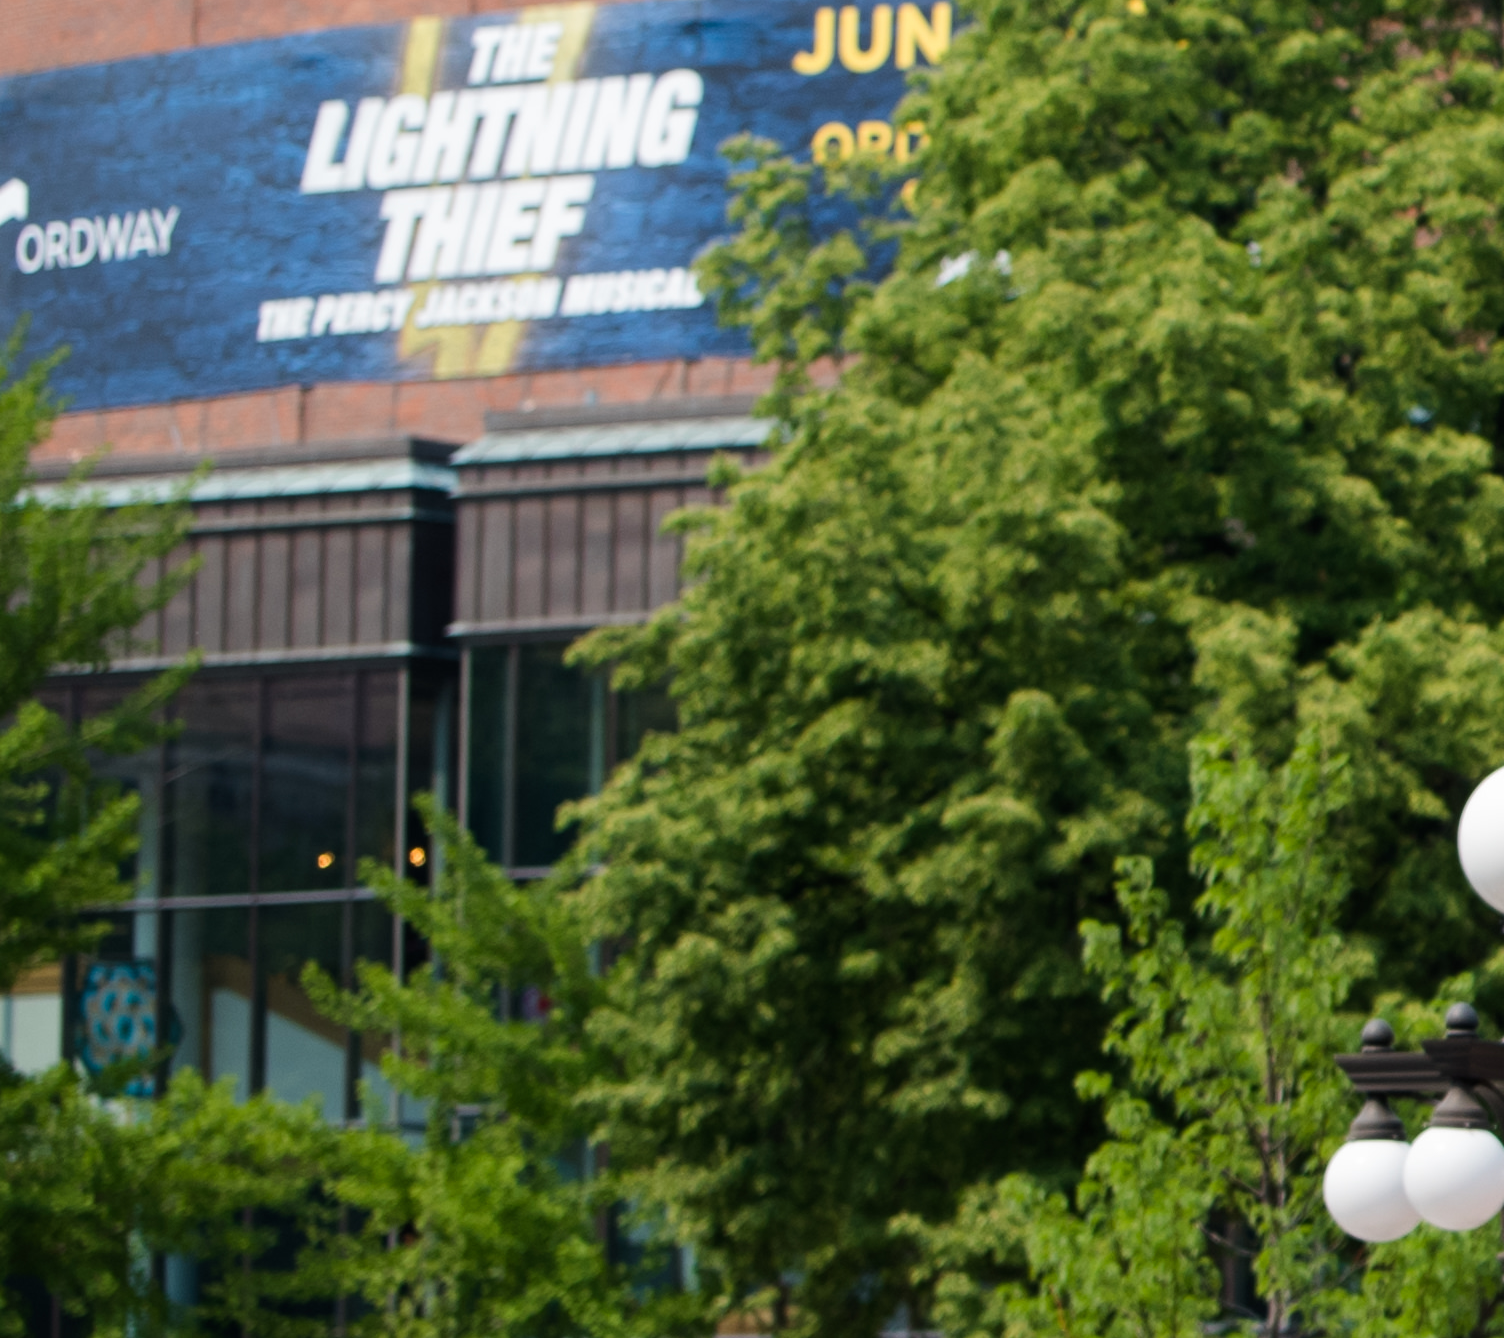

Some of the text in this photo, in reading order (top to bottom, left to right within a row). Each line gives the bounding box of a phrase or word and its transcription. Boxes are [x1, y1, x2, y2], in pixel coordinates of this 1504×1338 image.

[466, 21, 565, 86] THE
[301, 67, 705, 196] LIGHTNING
[15, 205, 182, 275] ORDWAY
[373, 173, 597, 285] THIEF
[256, 266, 706, 343] THE PERCY JACKSON MUSICAL
